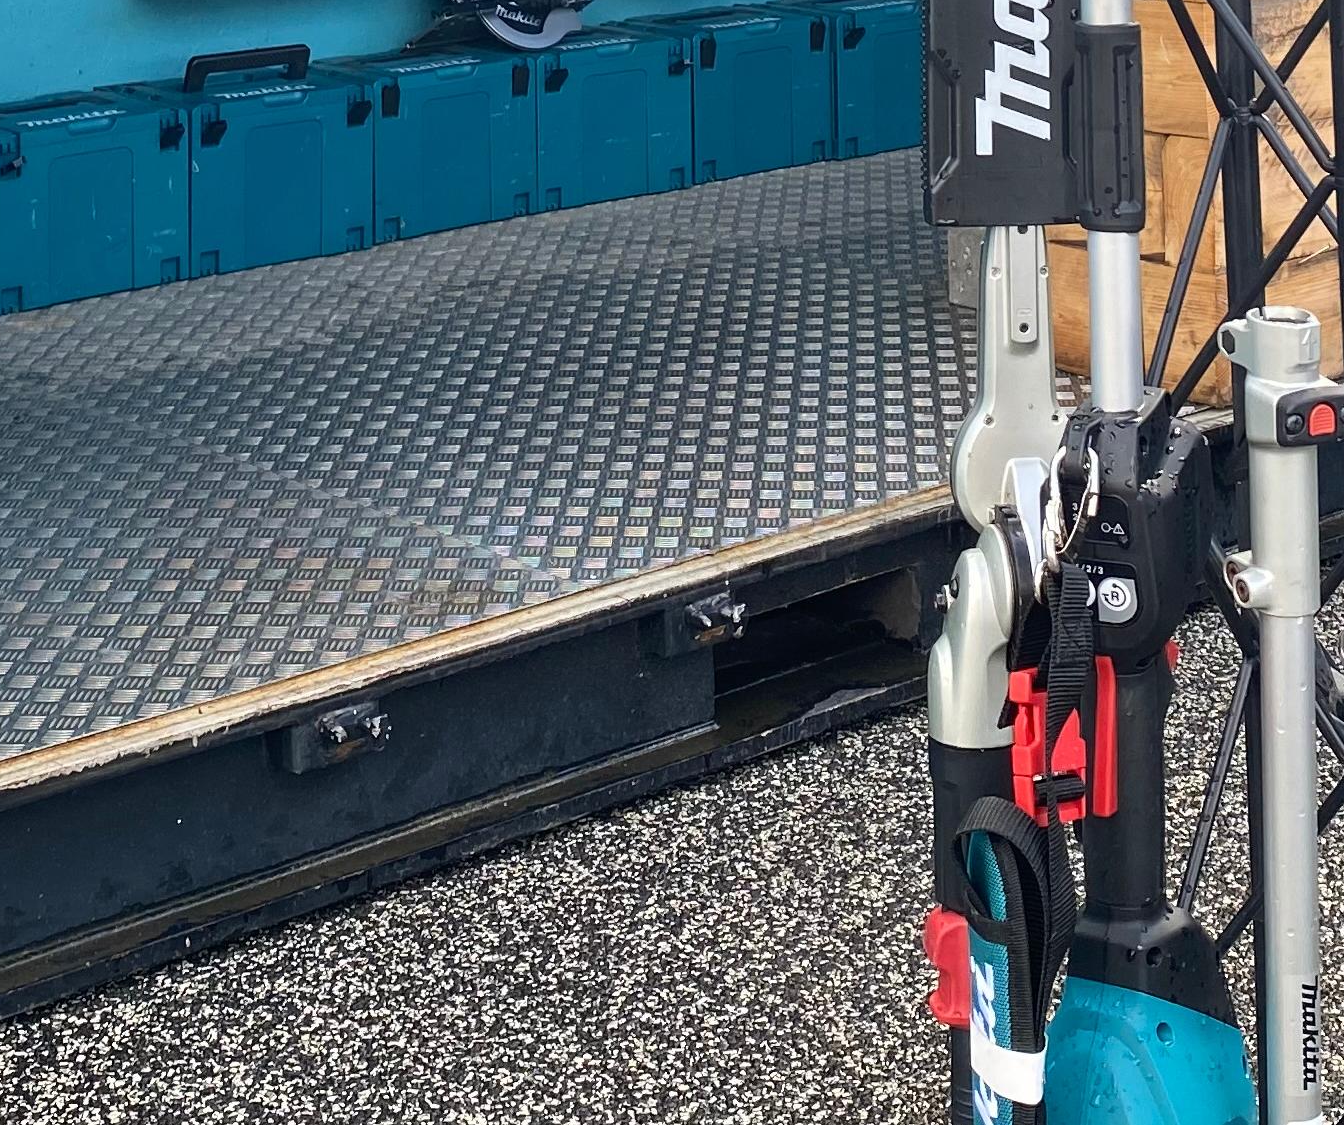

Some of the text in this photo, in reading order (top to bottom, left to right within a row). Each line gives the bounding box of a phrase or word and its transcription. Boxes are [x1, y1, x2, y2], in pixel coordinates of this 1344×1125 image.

[496, 4, 542, 26] Makita
[387, 56, 482, 73] Makita
[213, 84, 317, 99] Makita
[16, 109, 128, 127] Makita
[1110, 590, 1120, 602] R
[1301, 979, 1322, 1091] Makita
